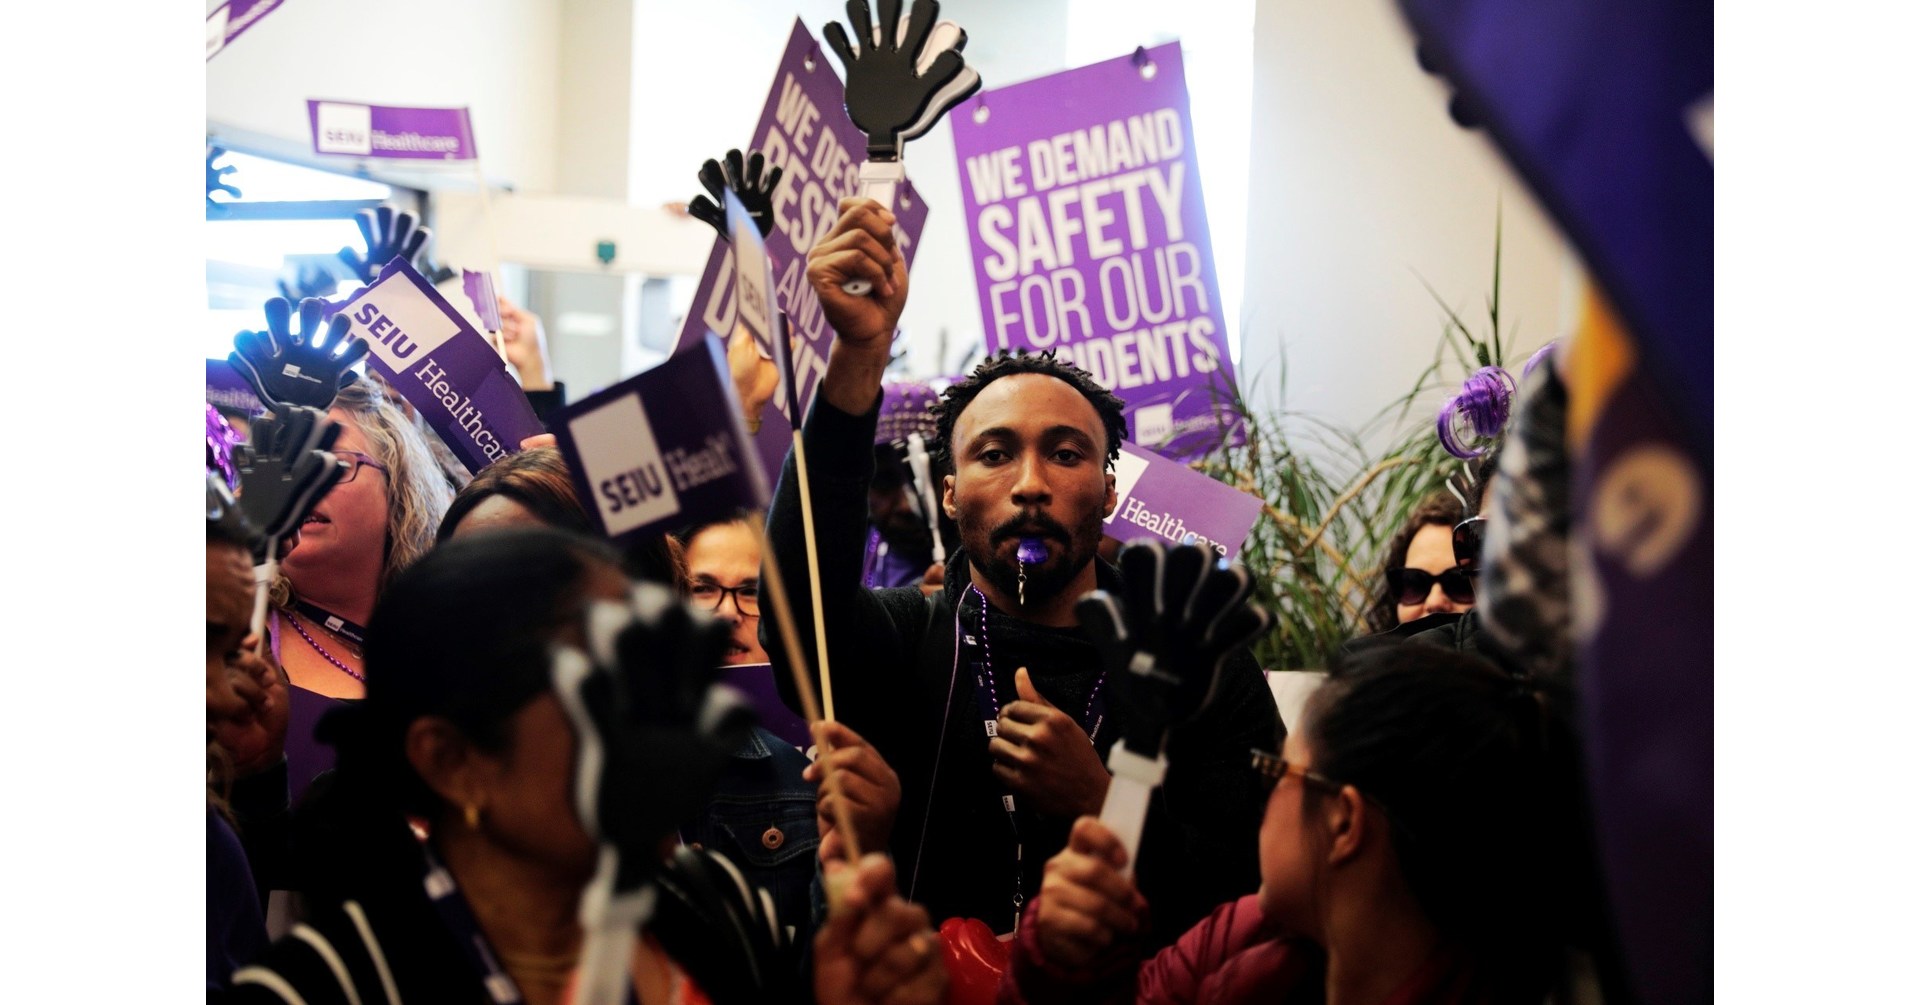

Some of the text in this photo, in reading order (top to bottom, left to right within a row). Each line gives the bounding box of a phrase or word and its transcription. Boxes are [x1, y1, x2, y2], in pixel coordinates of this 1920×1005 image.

[776, 71, 821, 157] WE
[966, 146, 1027, 206] WE
[1027, 108, 1185, 192] DEMAND
[977, 161, 1185, 282] SAFETY
[990, 242, 1208, 348] FOR OUR
[354, 303, 509, 463] SEIU Healthcar
[601, 461, 662, 514] SEIU
